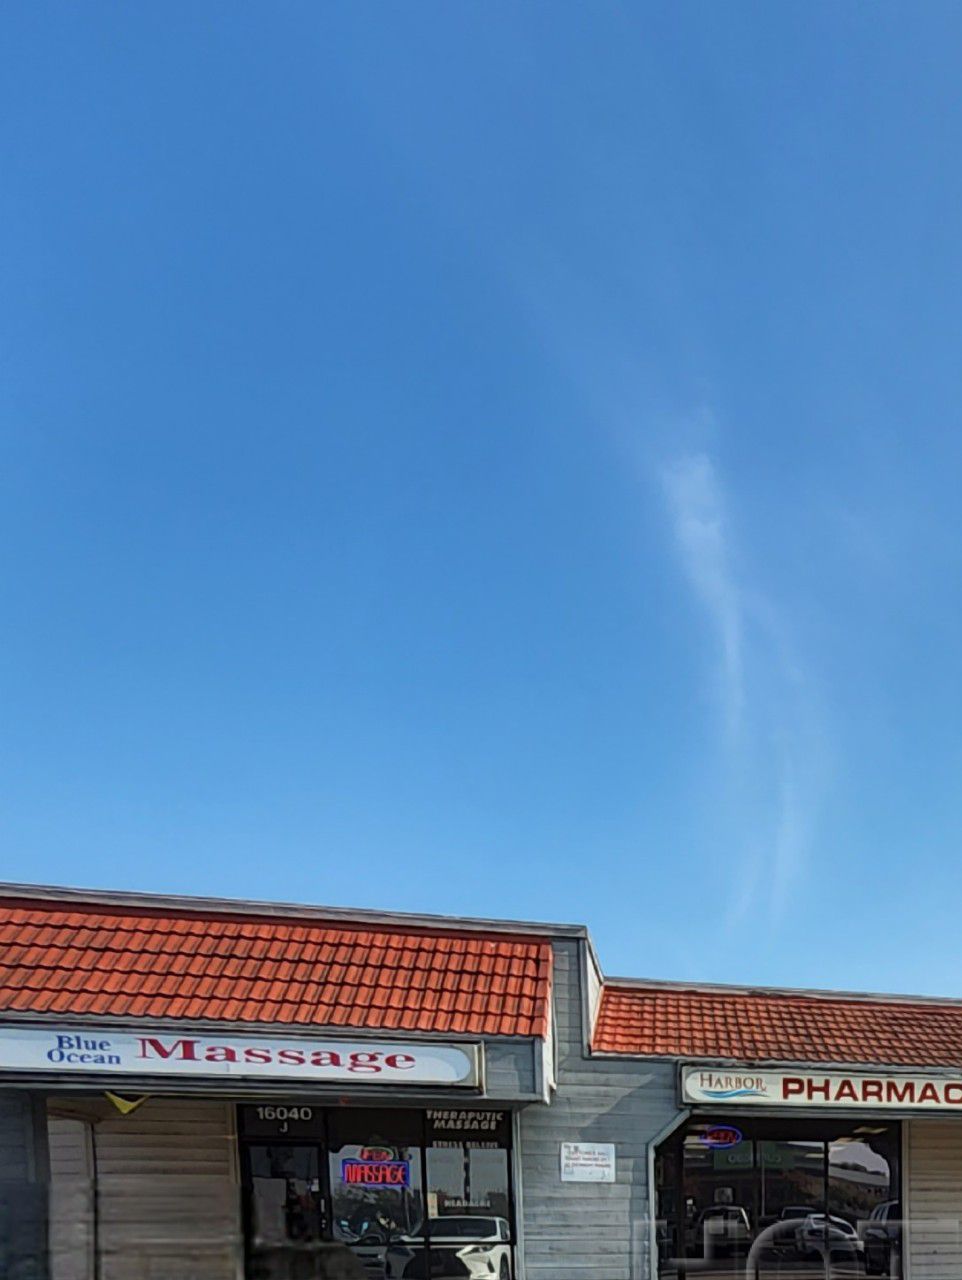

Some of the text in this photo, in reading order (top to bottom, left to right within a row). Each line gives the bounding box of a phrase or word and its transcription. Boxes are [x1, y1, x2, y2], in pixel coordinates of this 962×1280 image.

[56, 1035, 111, 1051] Blue
[47, 1049, 121, 1065] Ocean
[135, 1037, 416, 1073] Massage
[256, 1107, 312, 1120] 16040
[280, 1122, 288, 1133] J
[433, 1120, 497, 1130] MASSAGE
[345, 1164, 405, 1184] MASSAGE
